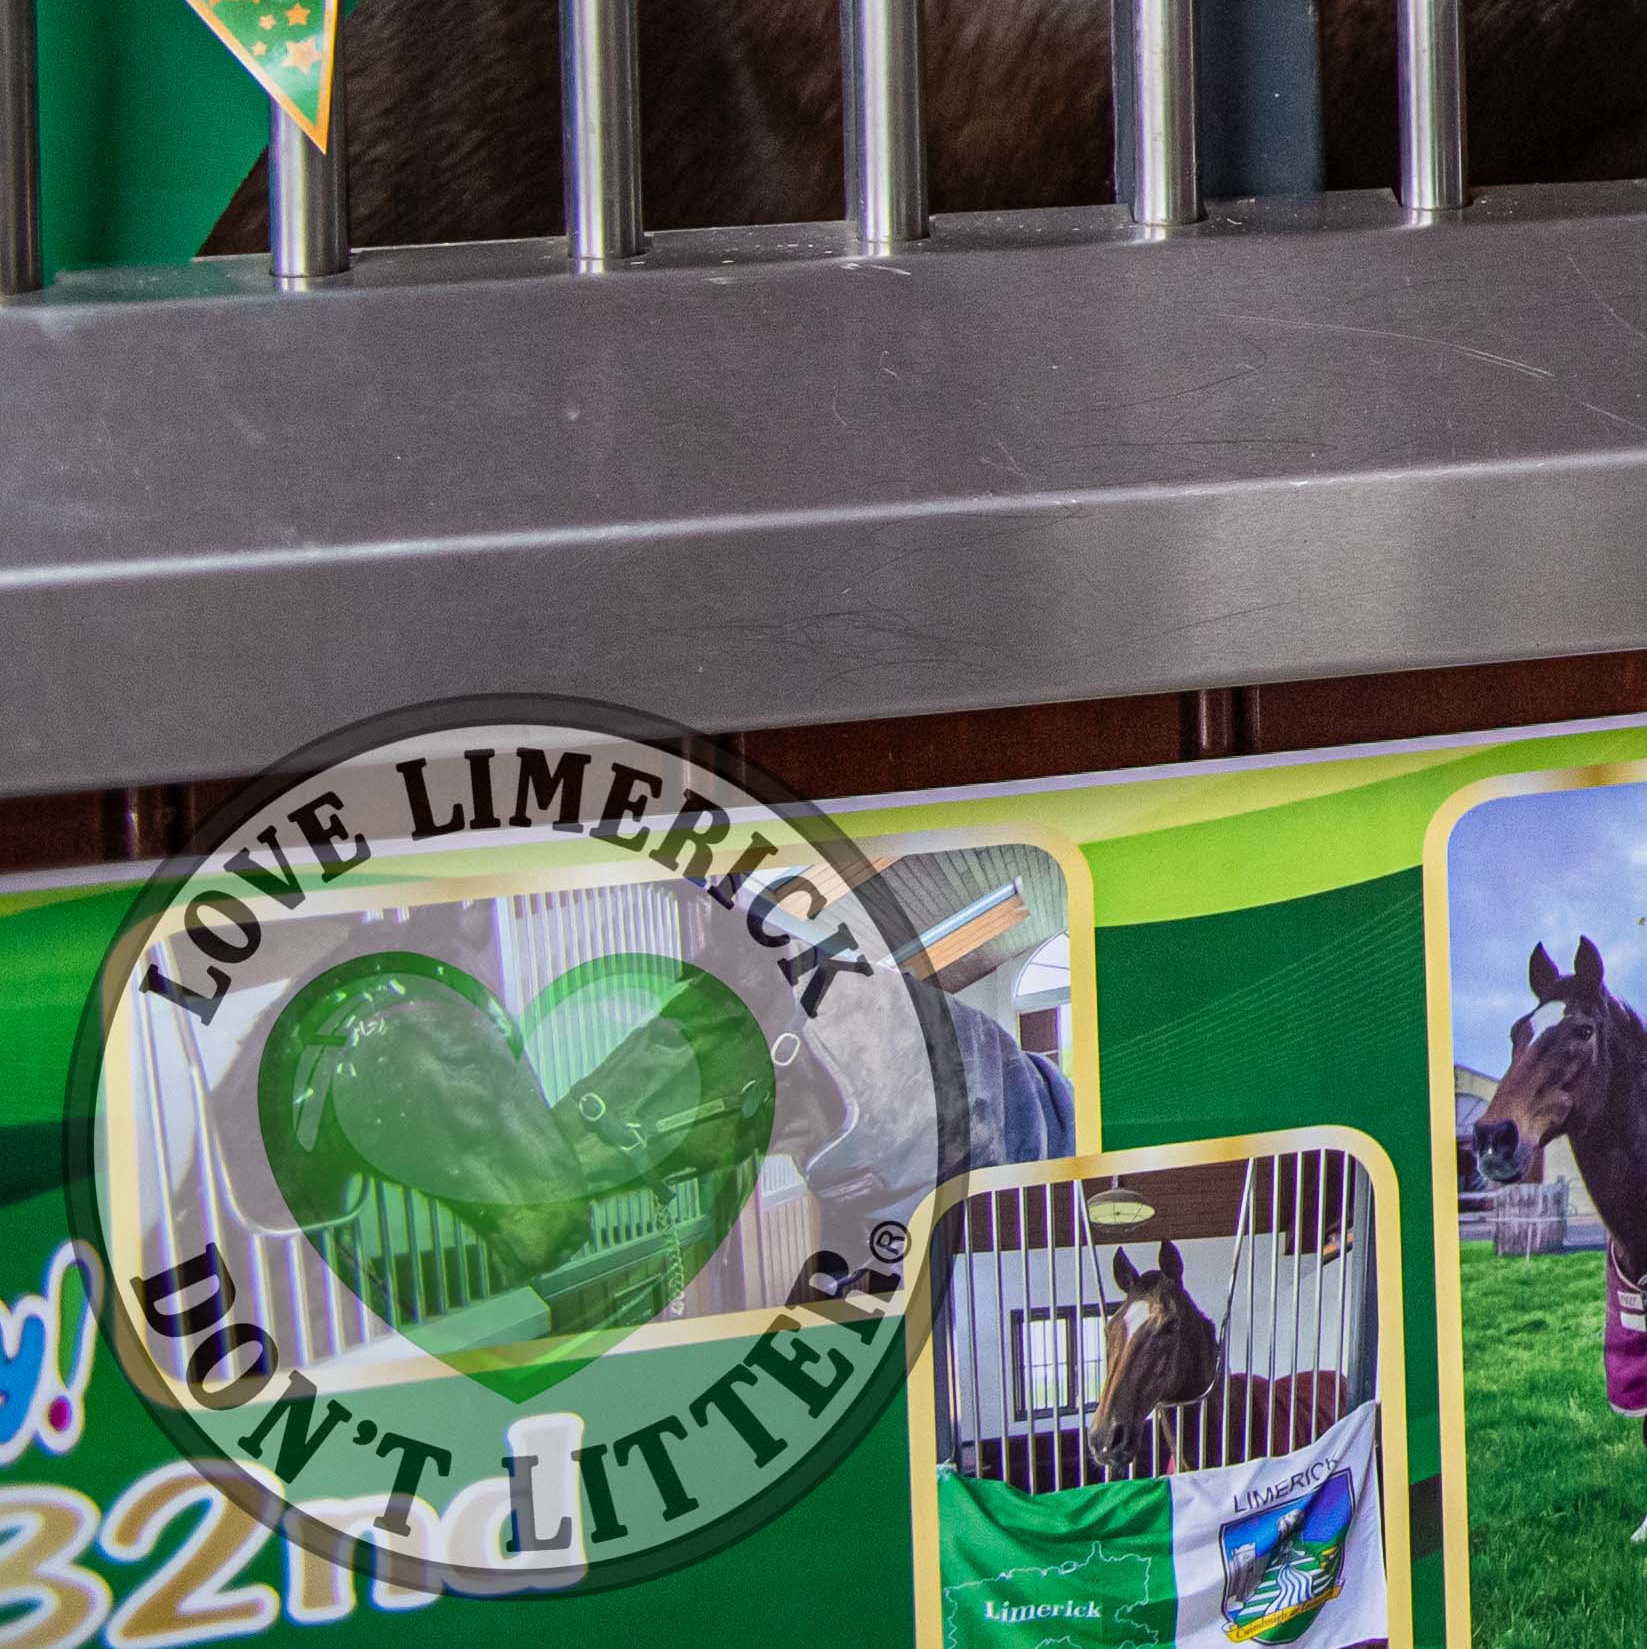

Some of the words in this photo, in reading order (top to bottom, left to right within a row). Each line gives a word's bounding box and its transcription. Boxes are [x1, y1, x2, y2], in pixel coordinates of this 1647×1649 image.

[1233, 1452, 1338, 1514] LIMERICK
[0, 1412, 588, 1649] 32nd
[983, 1600, 1102, 1623] Limerick
